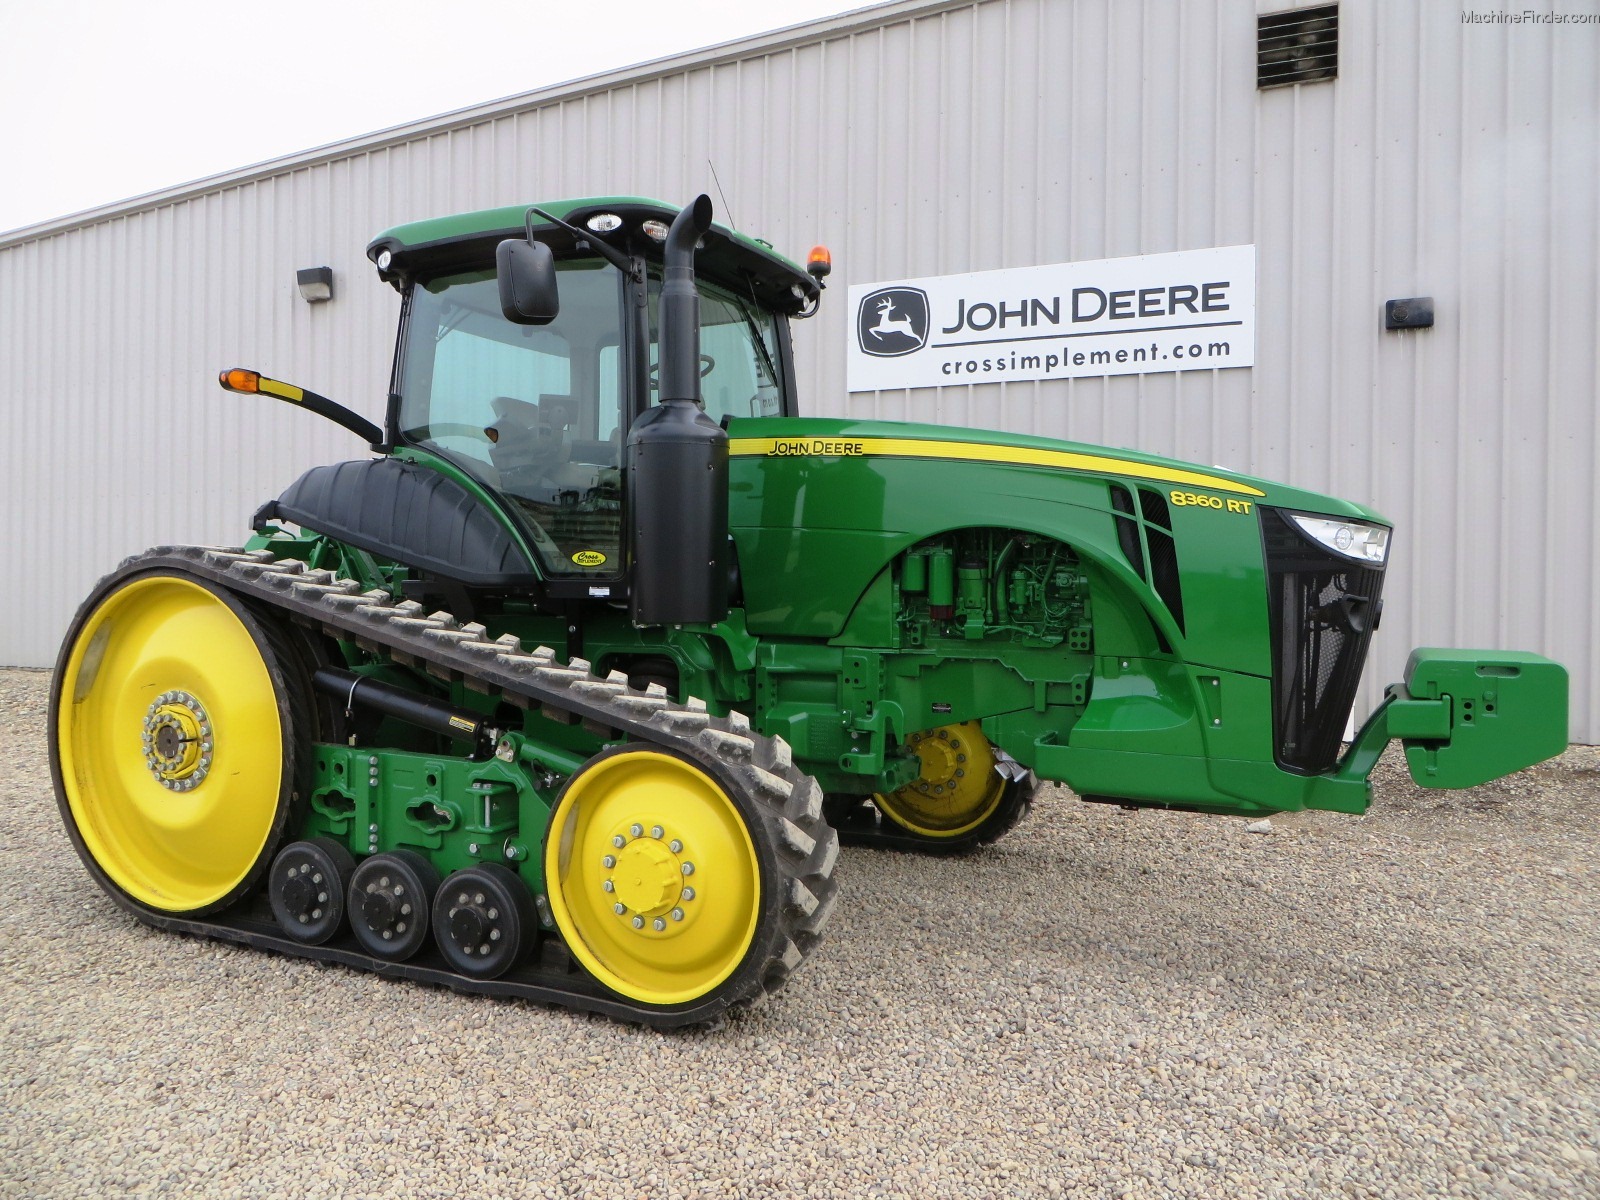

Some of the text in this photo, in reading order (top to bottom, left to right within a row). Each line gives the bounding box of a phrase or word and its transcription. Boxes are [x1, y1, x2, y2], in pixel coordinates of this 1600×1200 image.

[941, 281, 1230, 334] JOHN DEERE
[941, 341, 1230, 375] crossimplement.com
[769, 440, 863, 454] JOHN DEERE
[1169, 490, 1252, 515] 8360 RT
[577, 551, 599, 560] Cross
